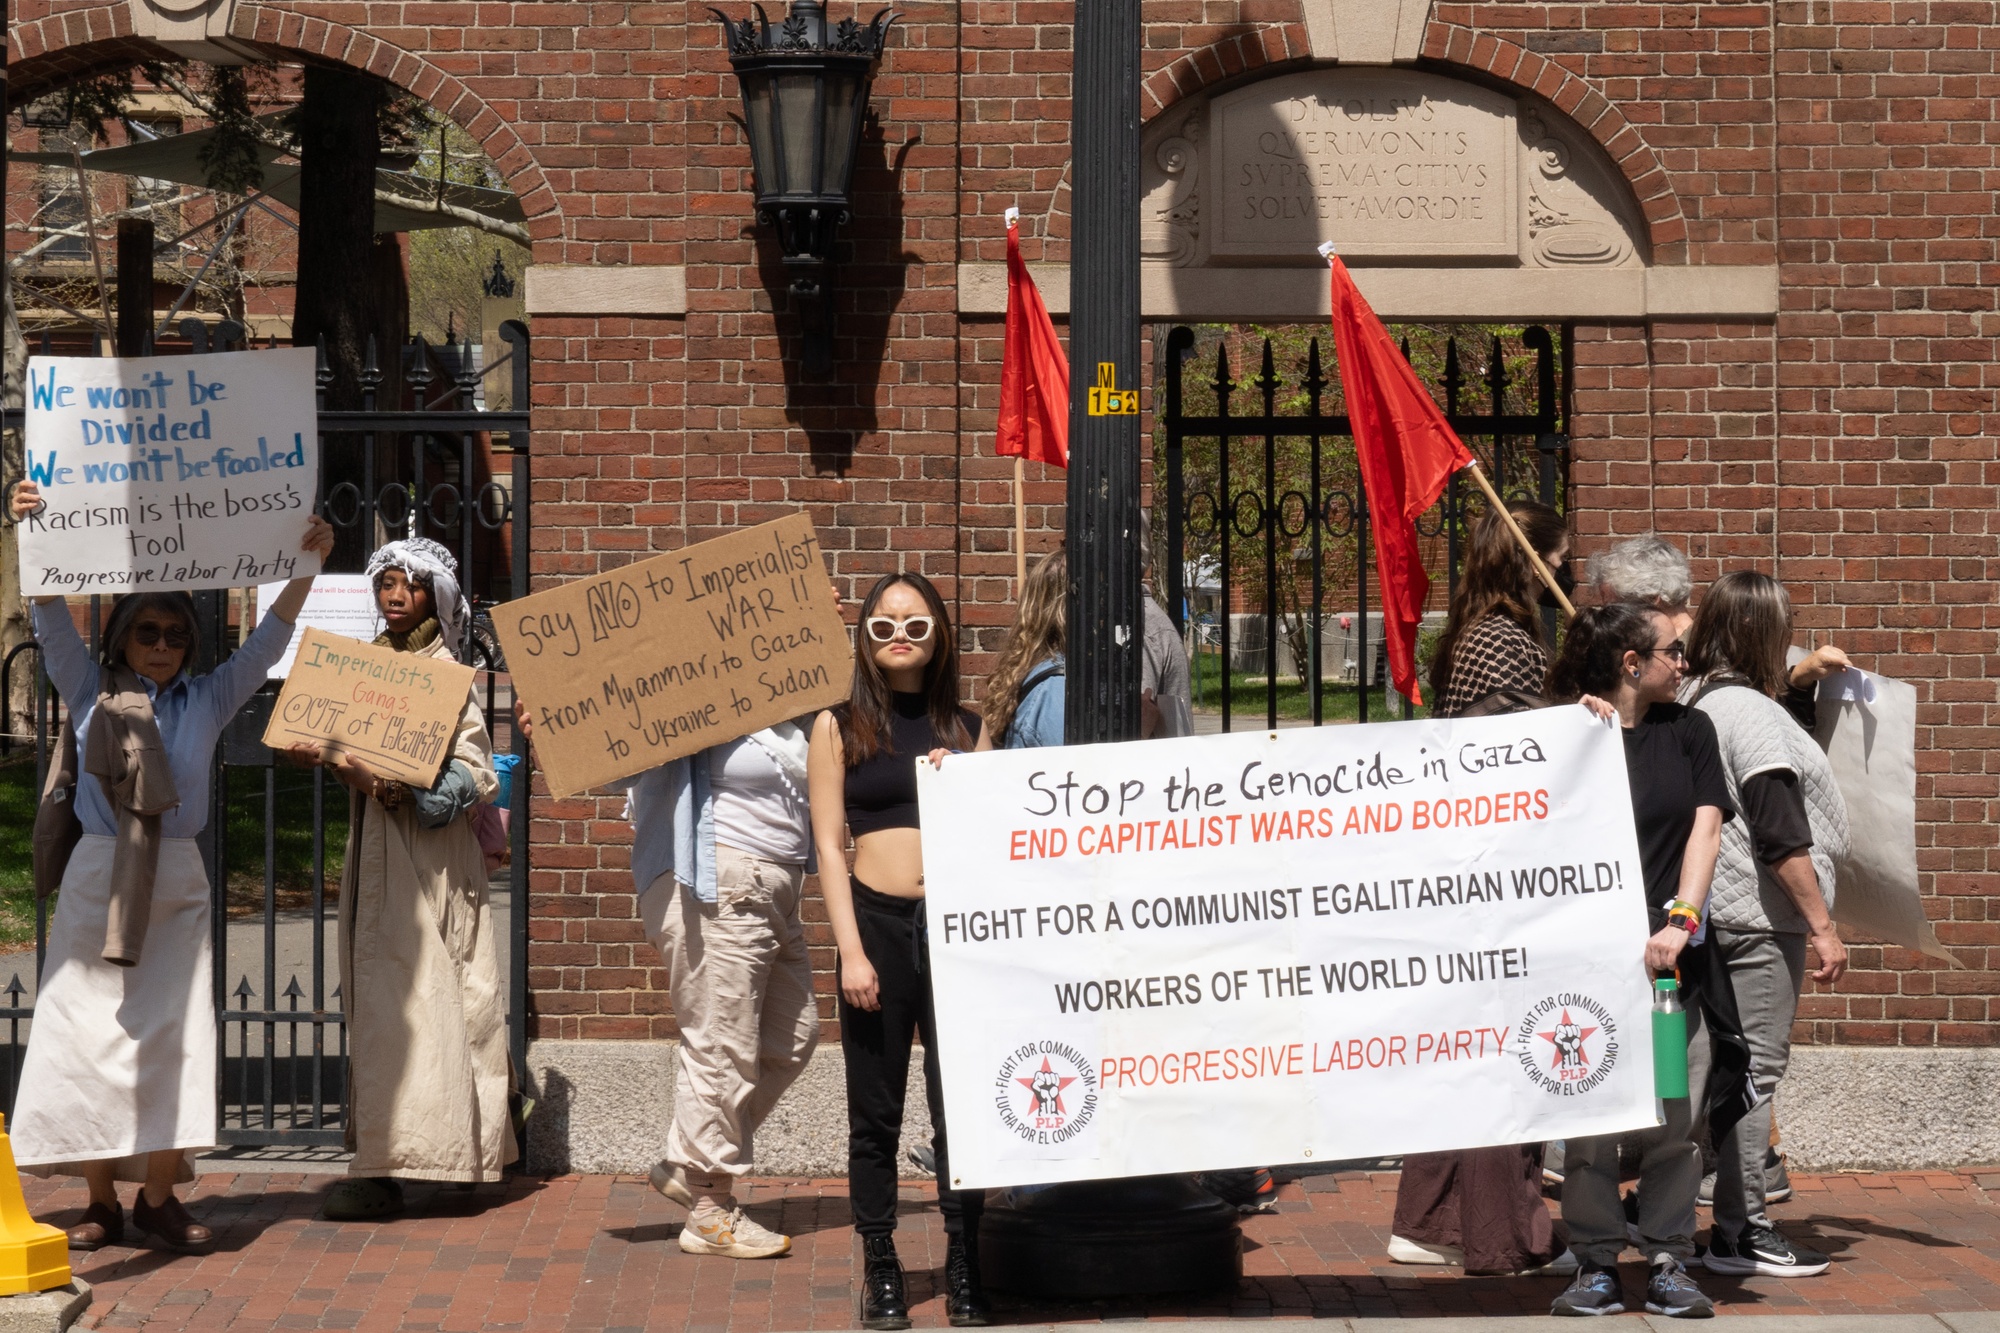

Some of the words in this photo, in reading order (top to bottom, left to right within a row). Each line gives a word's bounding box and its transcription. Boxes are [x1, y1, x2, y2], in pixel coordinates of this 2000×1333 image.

[1258, 131, 1468, 160] QVERIMONIIS
[1240, 163, 1381, 188] SVPREMA
[1394, 163, 1488, 188] CITIVS
[1441, 196, 1485, 220] DIE
[31, 366, 77, 411] We
[87, 371, 174, 410] won't
[187, 370, 229, 406] be
[1099, 364, 1112, 388] M
[1092, 390, 1136, 413] 152
[80, 409, 211, 446] Divided
[27, 449, 76, 487] We
[82, 447, 174, 484] won't
[174, 446, 211, 482] be
[211, 432, 305, 478] fooled
[28, 498, 129, 533] Racism
[139, 496, 162, 523] is
[170, 492, 215, 520] the
[224, 483, 301, 518] boss's
[126, 523, 185, 557] tool
[40, 567, 155, 592] Progressive
[160, 560, 227, 582] Labor
[232, 550, 297, 580] Party
[586, 580, 640, 643] NO
[644, 570, 674, 602] to
[679, 530, 817, 608] Imperialist
[707, 588, 785, 642] WAR
[304, 642, 436, 695] Imperialists,
[540, 696, 599, 735] from
[602, 653, 719, 731] Myanmar,
[720, 649, 743, 675] to
[750, 626, 823, 662] Gaza,
[352, 681, 411, 720] Gangs,
[606, 730, 630, 761] to
[643, 702, 721, 747] Ukraine
[730, 688, 752, 718] to
[757, 664, 829, 702] Sudan
[283, 693, 348, 734] OUT
[347, 712, 379, 736] of
[380, 715, 447, 765] Haiti
[1024, 770, 1145, 817] Stop
[1163, 766, 1227, 813] the
[1240, 751, 1414, 801] Genocide
[1419, 747, 1449, 783] in
[1459, 737, 1547, 774] Gaza
[1009, 827, 1068, 861] END
[1077, 814, 1242, 856] CAPITALIST
[1250, 808, 1333, 843] WARS
[1342, 802, 1403, 836] AND
[1412, 788, 1549, 831] BORDERS
[943, 908, 1027, 944] FIGHT
[1036, 903, 1097, 937] FOR
[1104, 901, 1125, 932] A
[1132, 887, 1302, 930] COMMUNIST
[1312, 870, 1503, 917] EGALITARIAN
[1510, 860, 1623, 900] WORLD!
[1054, 973, 1202, 1014] WORKERS
[1211, 970, 1249, 1002] OF
[1257, 965, 1313, 999] THE
[1320, 956, 1428, 994] WORLD
[1436, 947, 1529, 985] UNITE!
[1518, 1011, 1539, 1043] FIGHT
[1534, 996, 1556, 1016] FOR
[1558, 993, 1617, 1035] COMMUNISM
[995, 1055, 1018, 1088] FIGHT
[1014, 1042, 1037, 1062] FOR
[1039, 1040, 1097, 1087] COMMUNISM
[1100, 1043, 1304, 1090] PROGRESSIVE
[1312, 1035, 1407, 1074] LABOR
[1416, 1026, 1510, 1064] PARTY
[1518, 1051, 1543, 1084] LUCHA
[1540, 1077, 1561, 1095] POR
[1563, 1083, 1575, 1096] EL
[1577, 1042, 1619, 1093] COMUNISMO
[1559, 1067, 1588, 1081] PLP
[995, 1095, 1018, 1129] LUCHA
[1014, 1122, 1036, 1142] POR
[1038, 1131, 1049, 1145] EL
[1052, 1094, 1098, 1143] COMUNISMO
[1035, 1117, 1064, 1129] PLP
